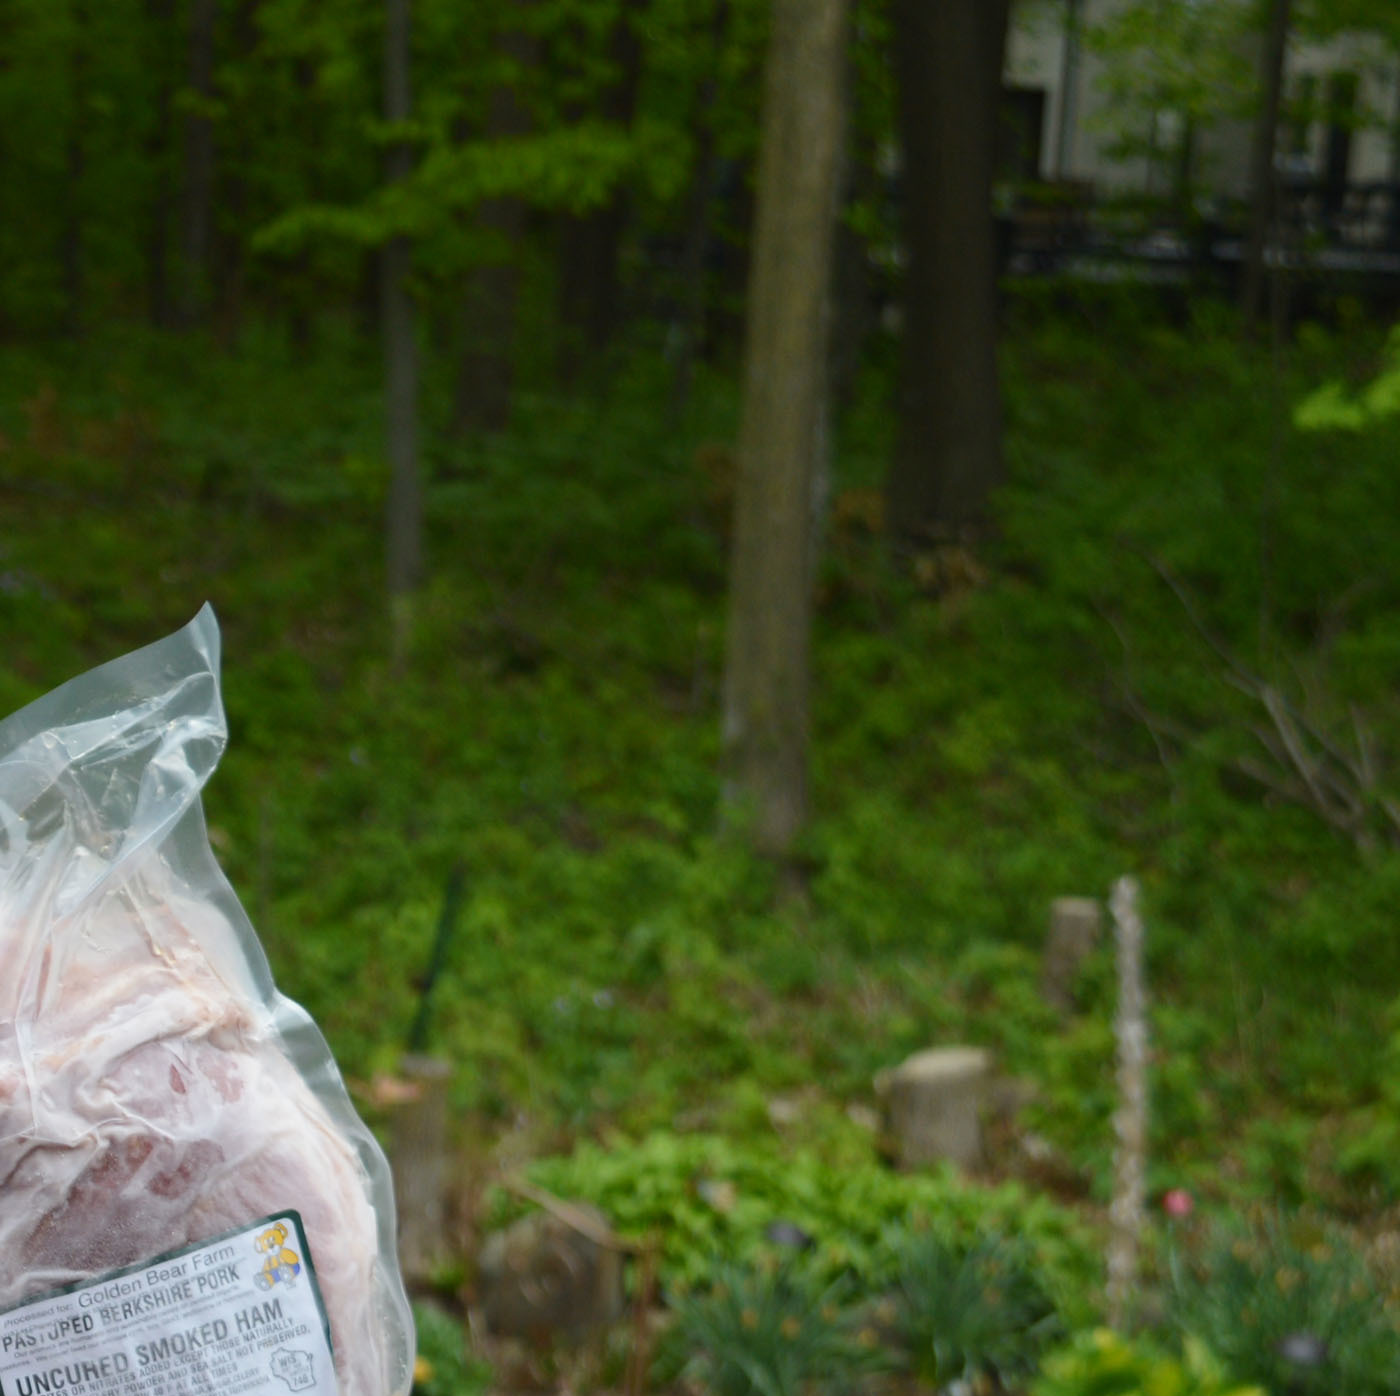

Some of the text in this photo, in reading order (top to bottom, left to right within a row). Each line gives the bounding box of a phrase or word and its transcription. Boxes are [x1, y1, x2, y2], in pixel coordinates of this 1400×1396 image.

[77, 1278, 142, 1310] Golden
[145, 1261, 189, 1287] Bear
[192, 1245, 236, 1271] Farm
[100, 1280, 193, 1326] BERKSHIRE
[198, 1262, 241, 1296] PORK
[135, 1318, 229, 1368] SMOKED
[234, 1300, 285, 1334] HAM
